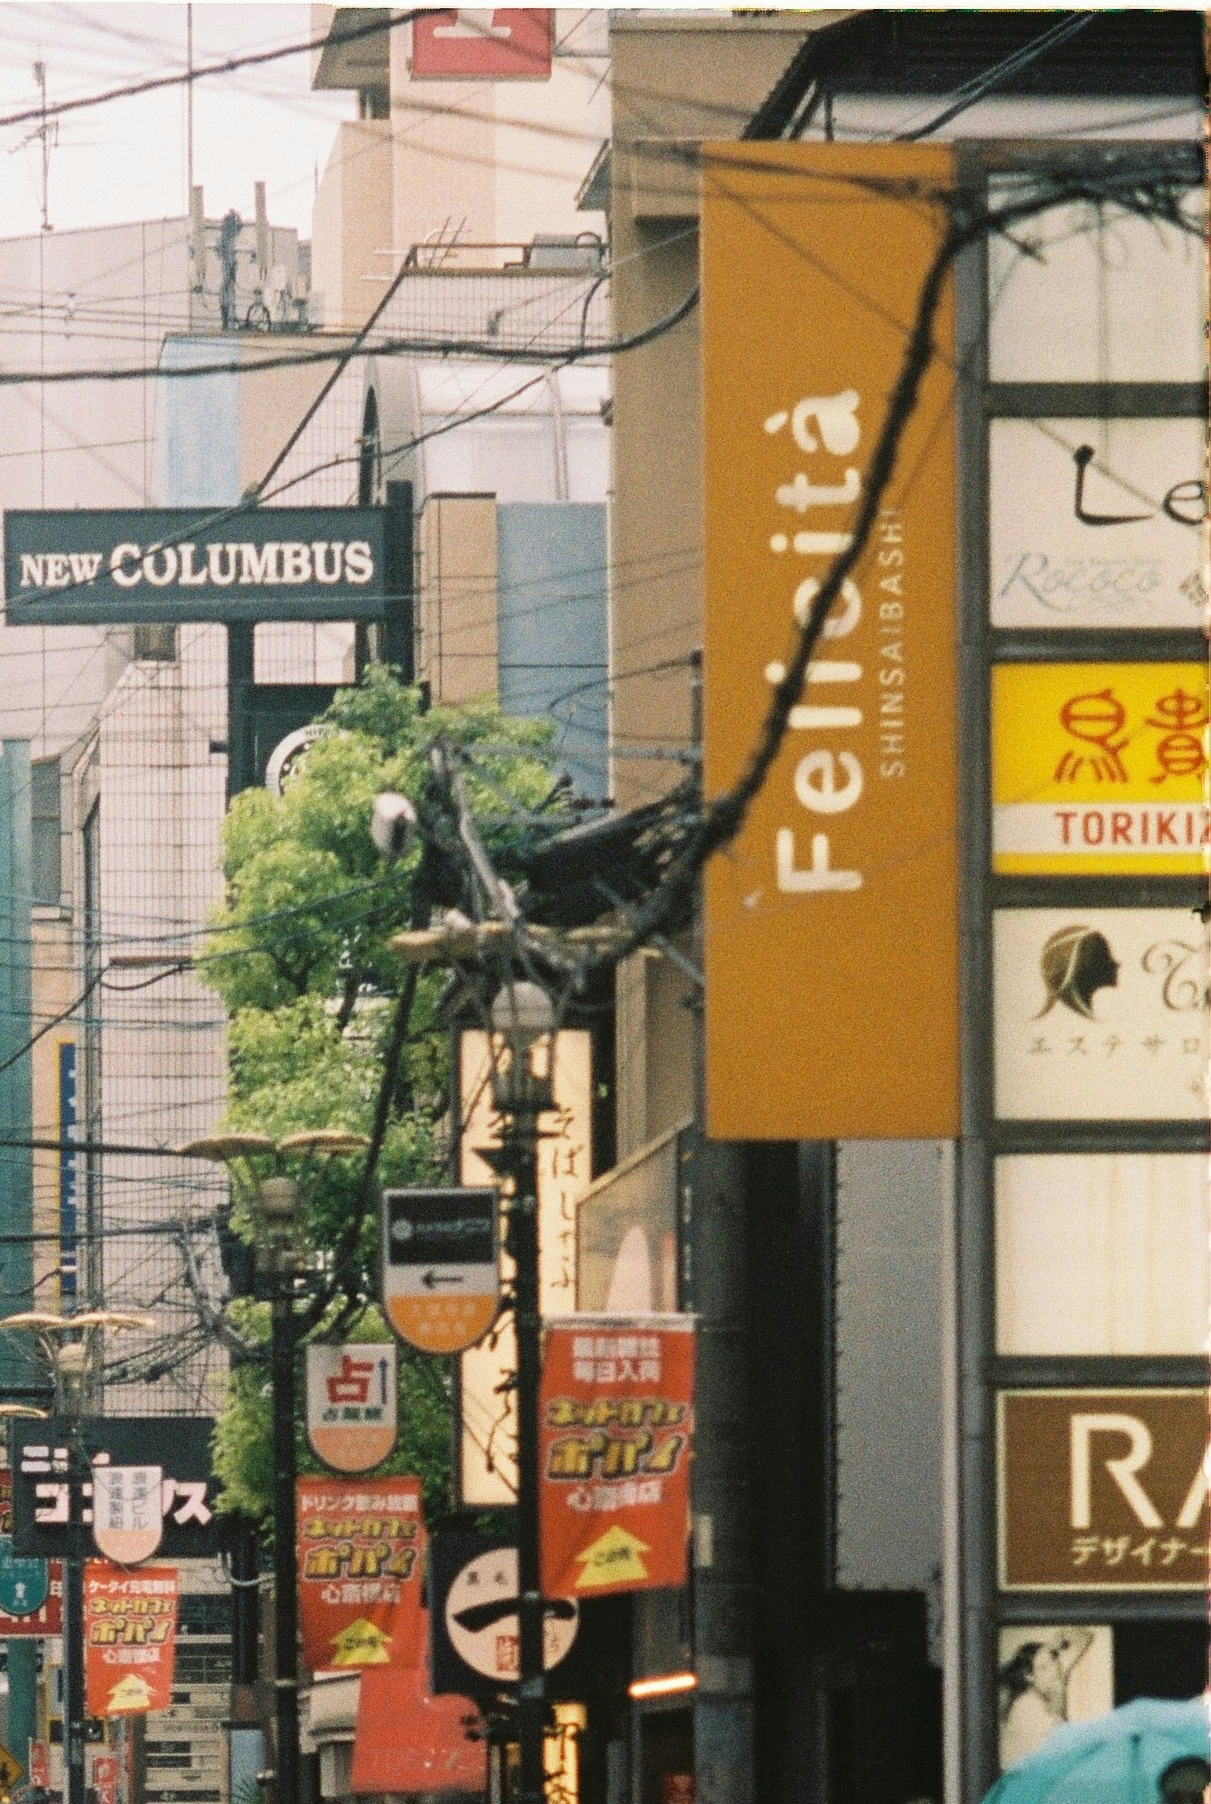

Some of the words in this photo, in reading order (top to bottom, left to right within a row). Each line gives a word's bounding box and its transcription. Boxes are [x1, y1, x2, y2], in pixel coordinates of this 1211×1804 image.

[21, 553, 103, 586] NEW
[111, 541, 374, 585] COLUMBUS
[764, 390, 864, 893] Felicità
[879, 507, 907, 778] SHINSAIBASHI
[327, 1354, 374, 1403] 占
[548, 1431, 683, 1479] ポパイ
[305, 1542, 416, 1579] ポパイ
[1071, 1536, 1210, 1567] デザイナー
[91, 1617, 172, 1645] ポパイ
